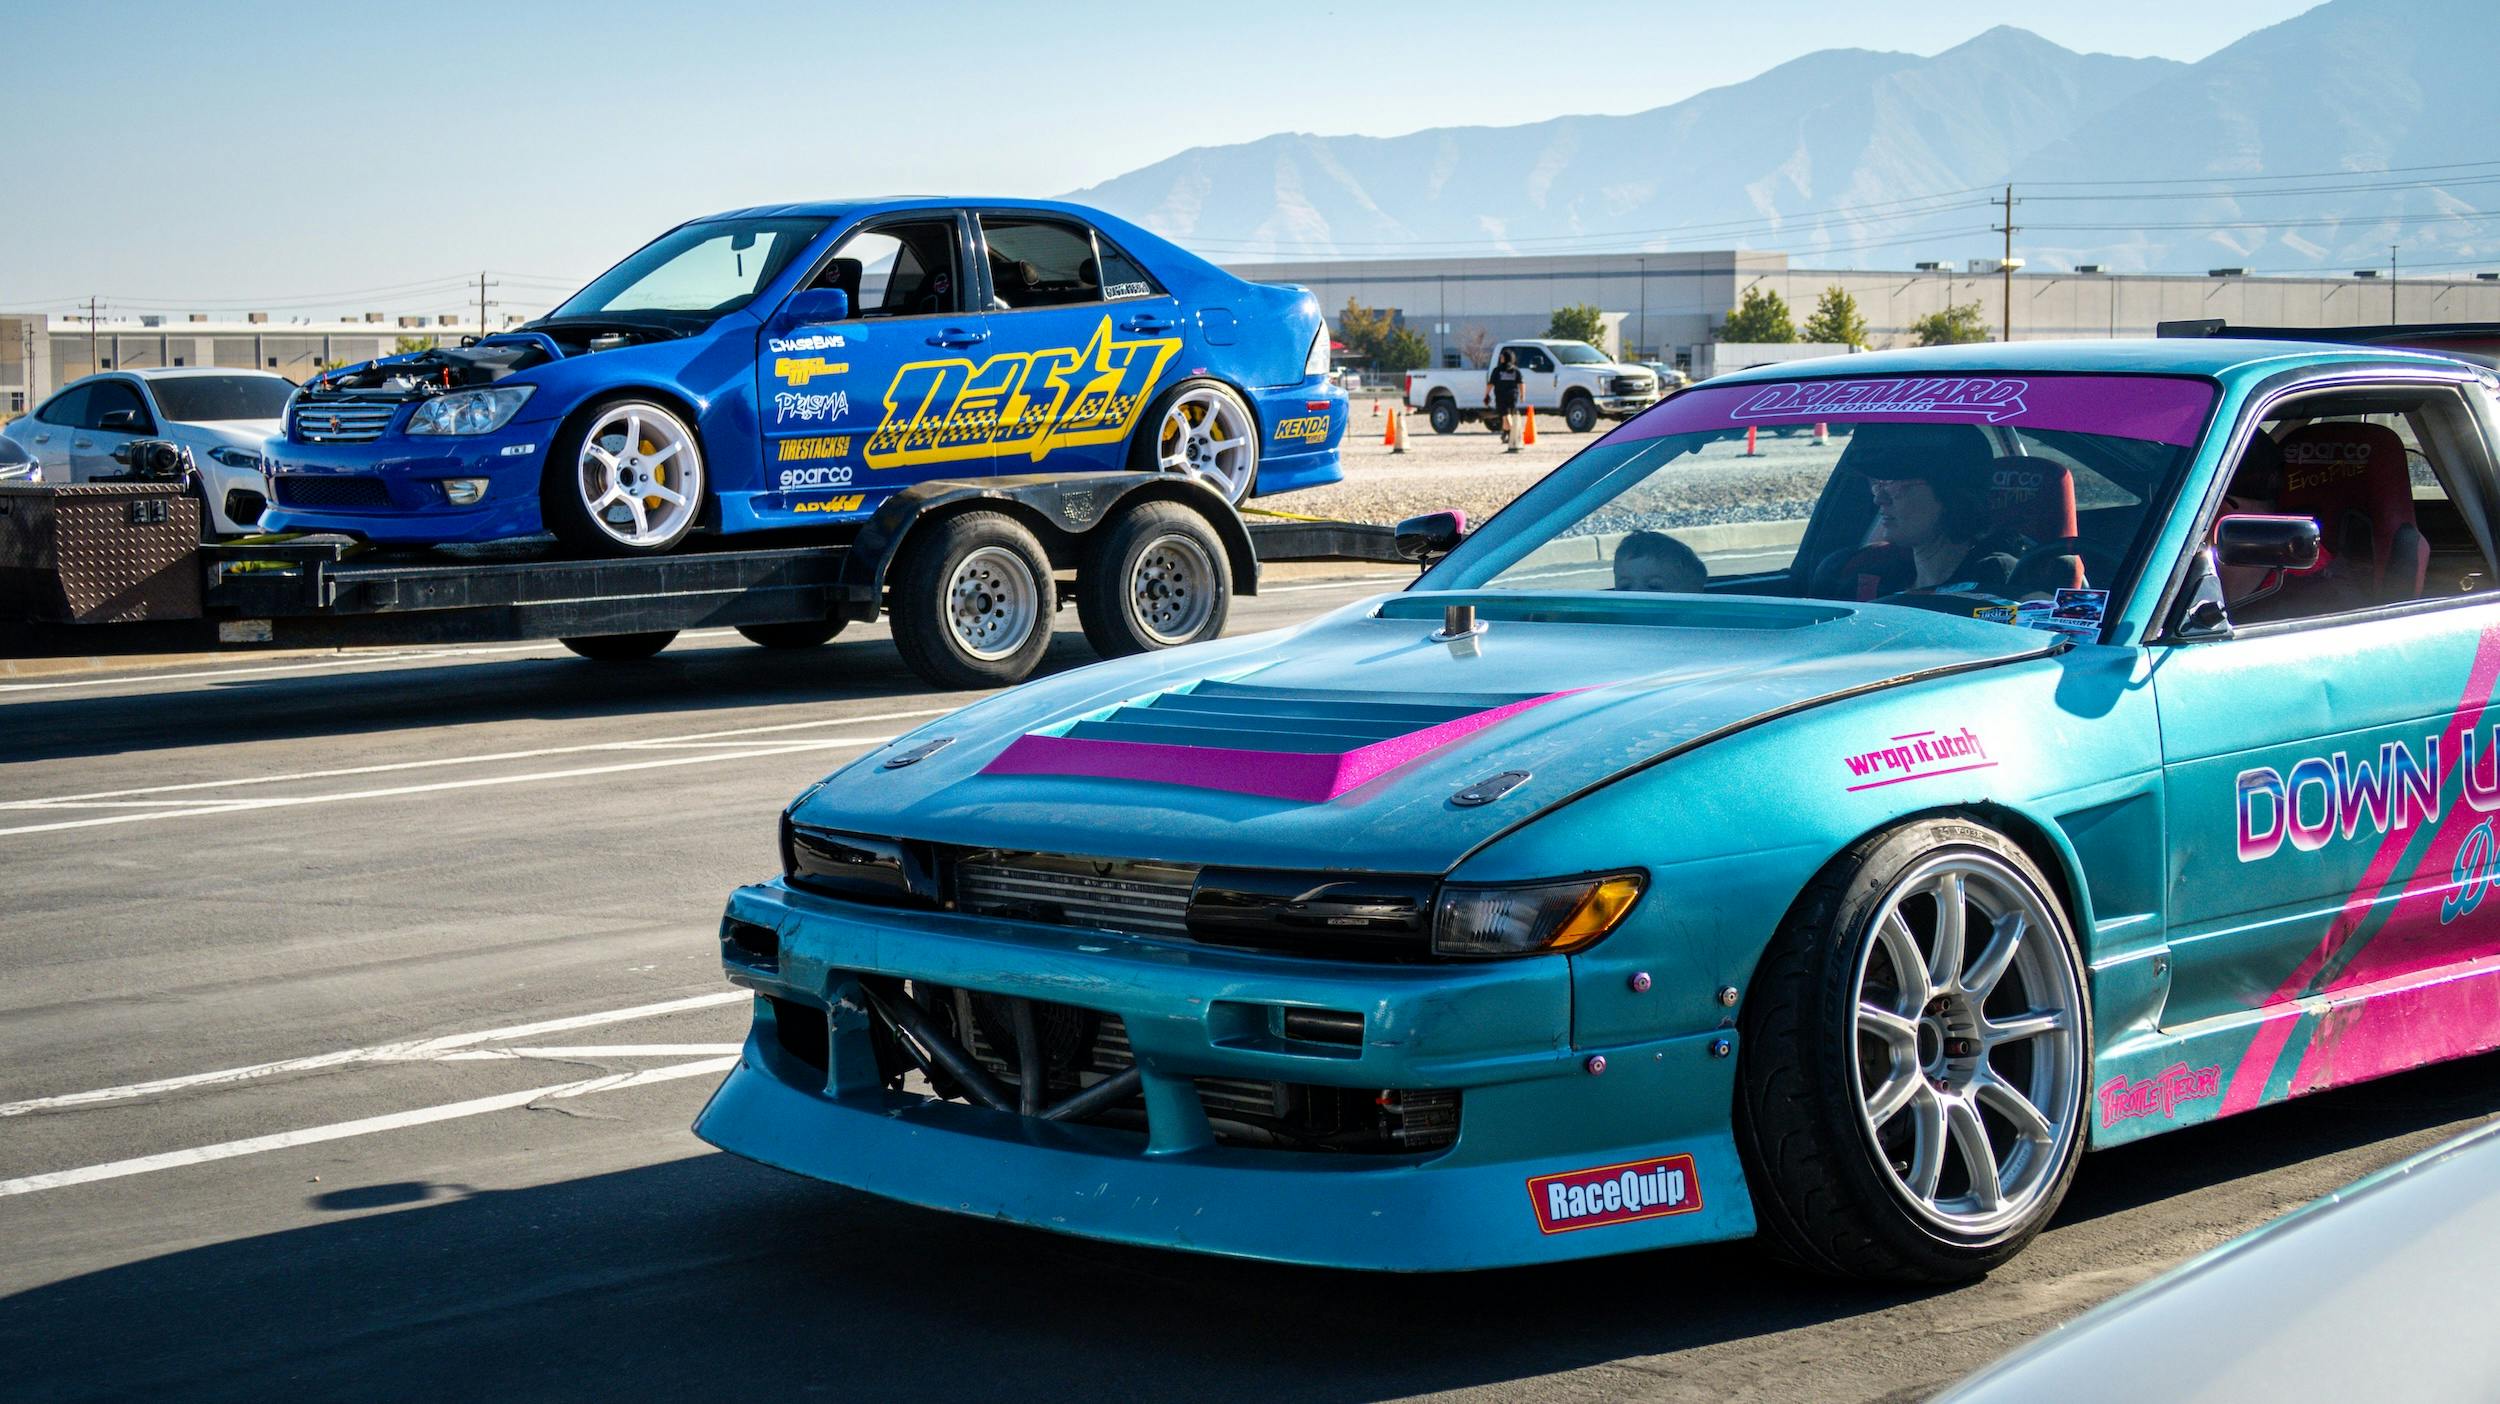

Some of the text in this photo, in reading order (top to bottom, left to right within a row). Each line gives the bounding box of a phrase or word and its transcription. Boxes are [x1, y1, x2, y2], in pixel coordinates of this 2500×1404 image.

[1740, 379, 2028, 412] DRIFTWARD
[1803, 401, 1935, 415] MOTORSPORTS
[1275, 416, 1329, 439] KENDA
[2285, 442, 2371, 464] sparco
[780, 466, 853, 490] sparco
[1845, 746, 1915, 773] wrap
[1931, 727, 1987, 759] utah
[2237, 735, 2440, 863] DOWN
[1547, 1165, 1686, 1221] RaceQuip
